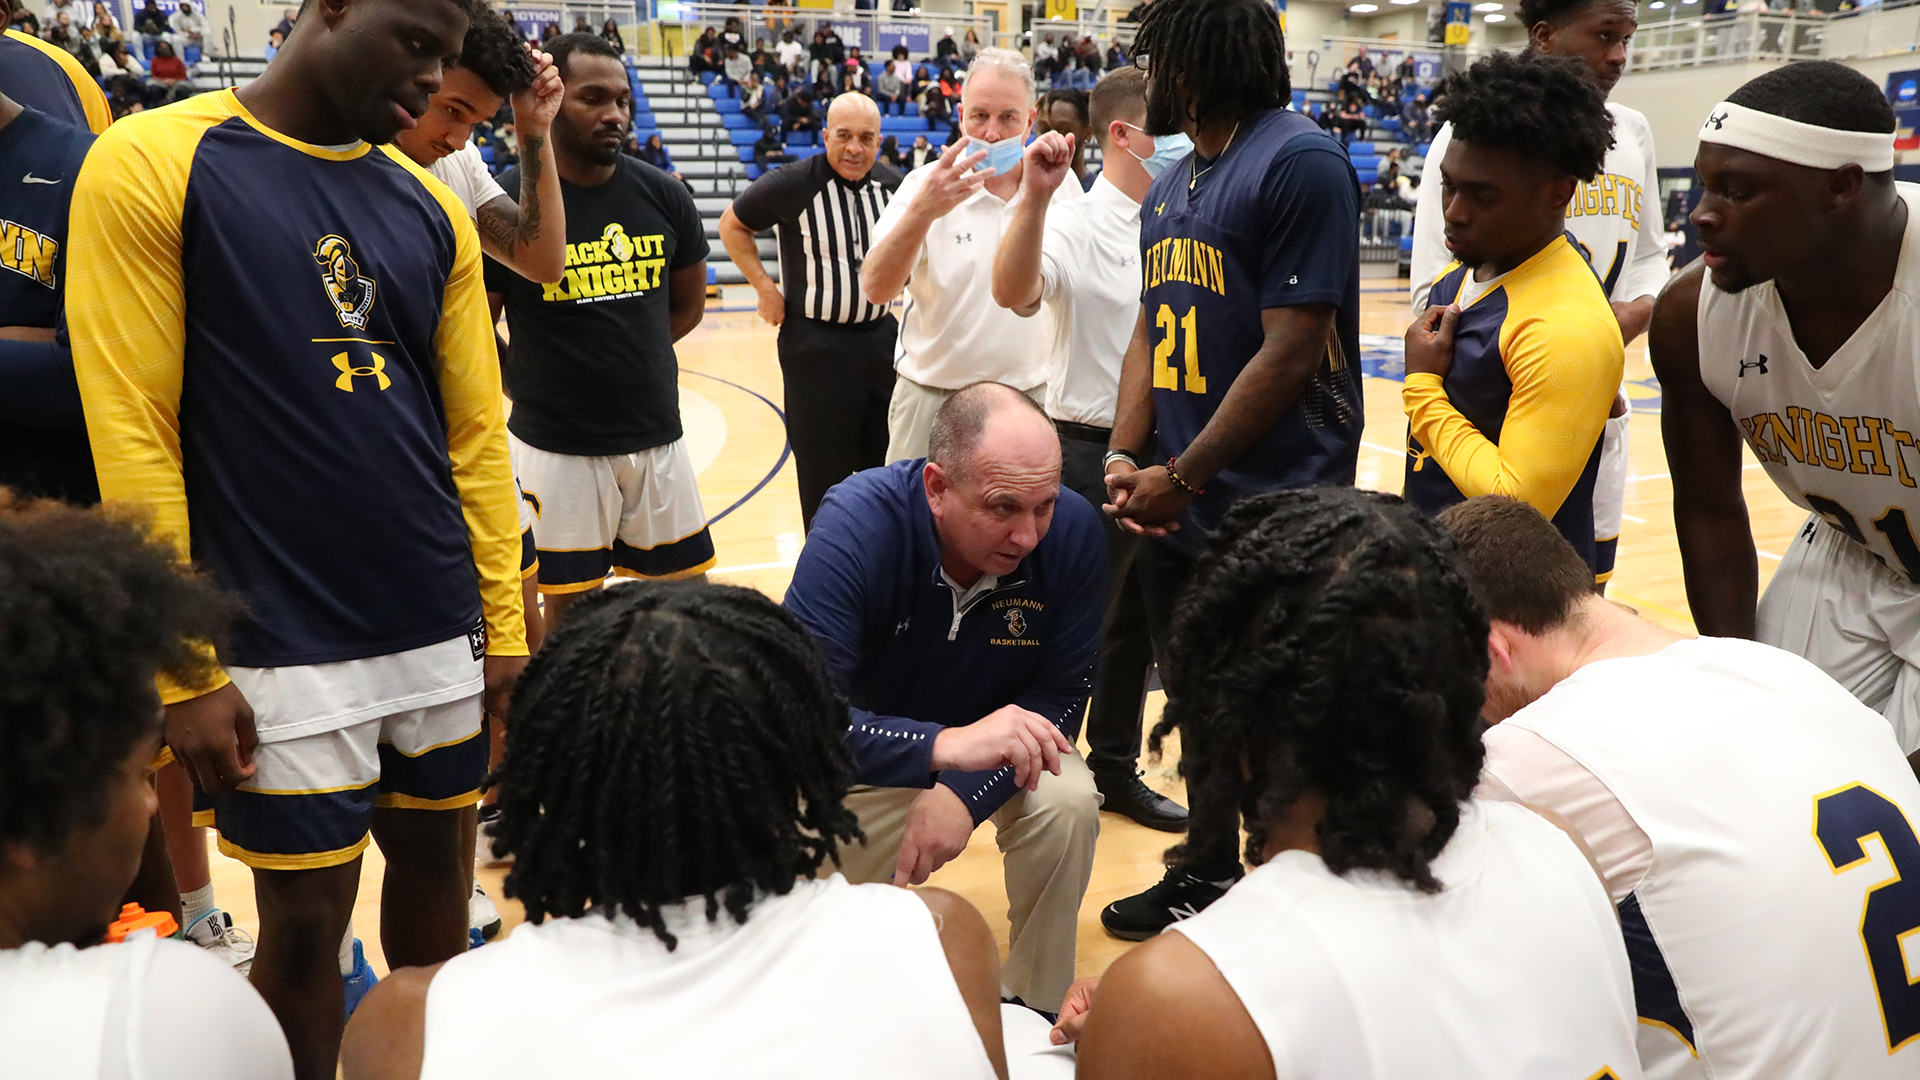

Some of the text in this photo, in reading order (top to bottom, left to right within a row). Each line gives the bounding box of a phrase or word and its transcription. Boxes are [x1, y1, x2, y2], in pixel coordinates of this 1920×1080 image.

[509, 10, 560, 22] ECTION
[1153, 303, 1207, 394] 21
[1740, 405, 1920, 488] KNIGHT
[991, 598, 1045, 612] NEUMANN
[990, 638, 1041, 646] BASKETBALL
